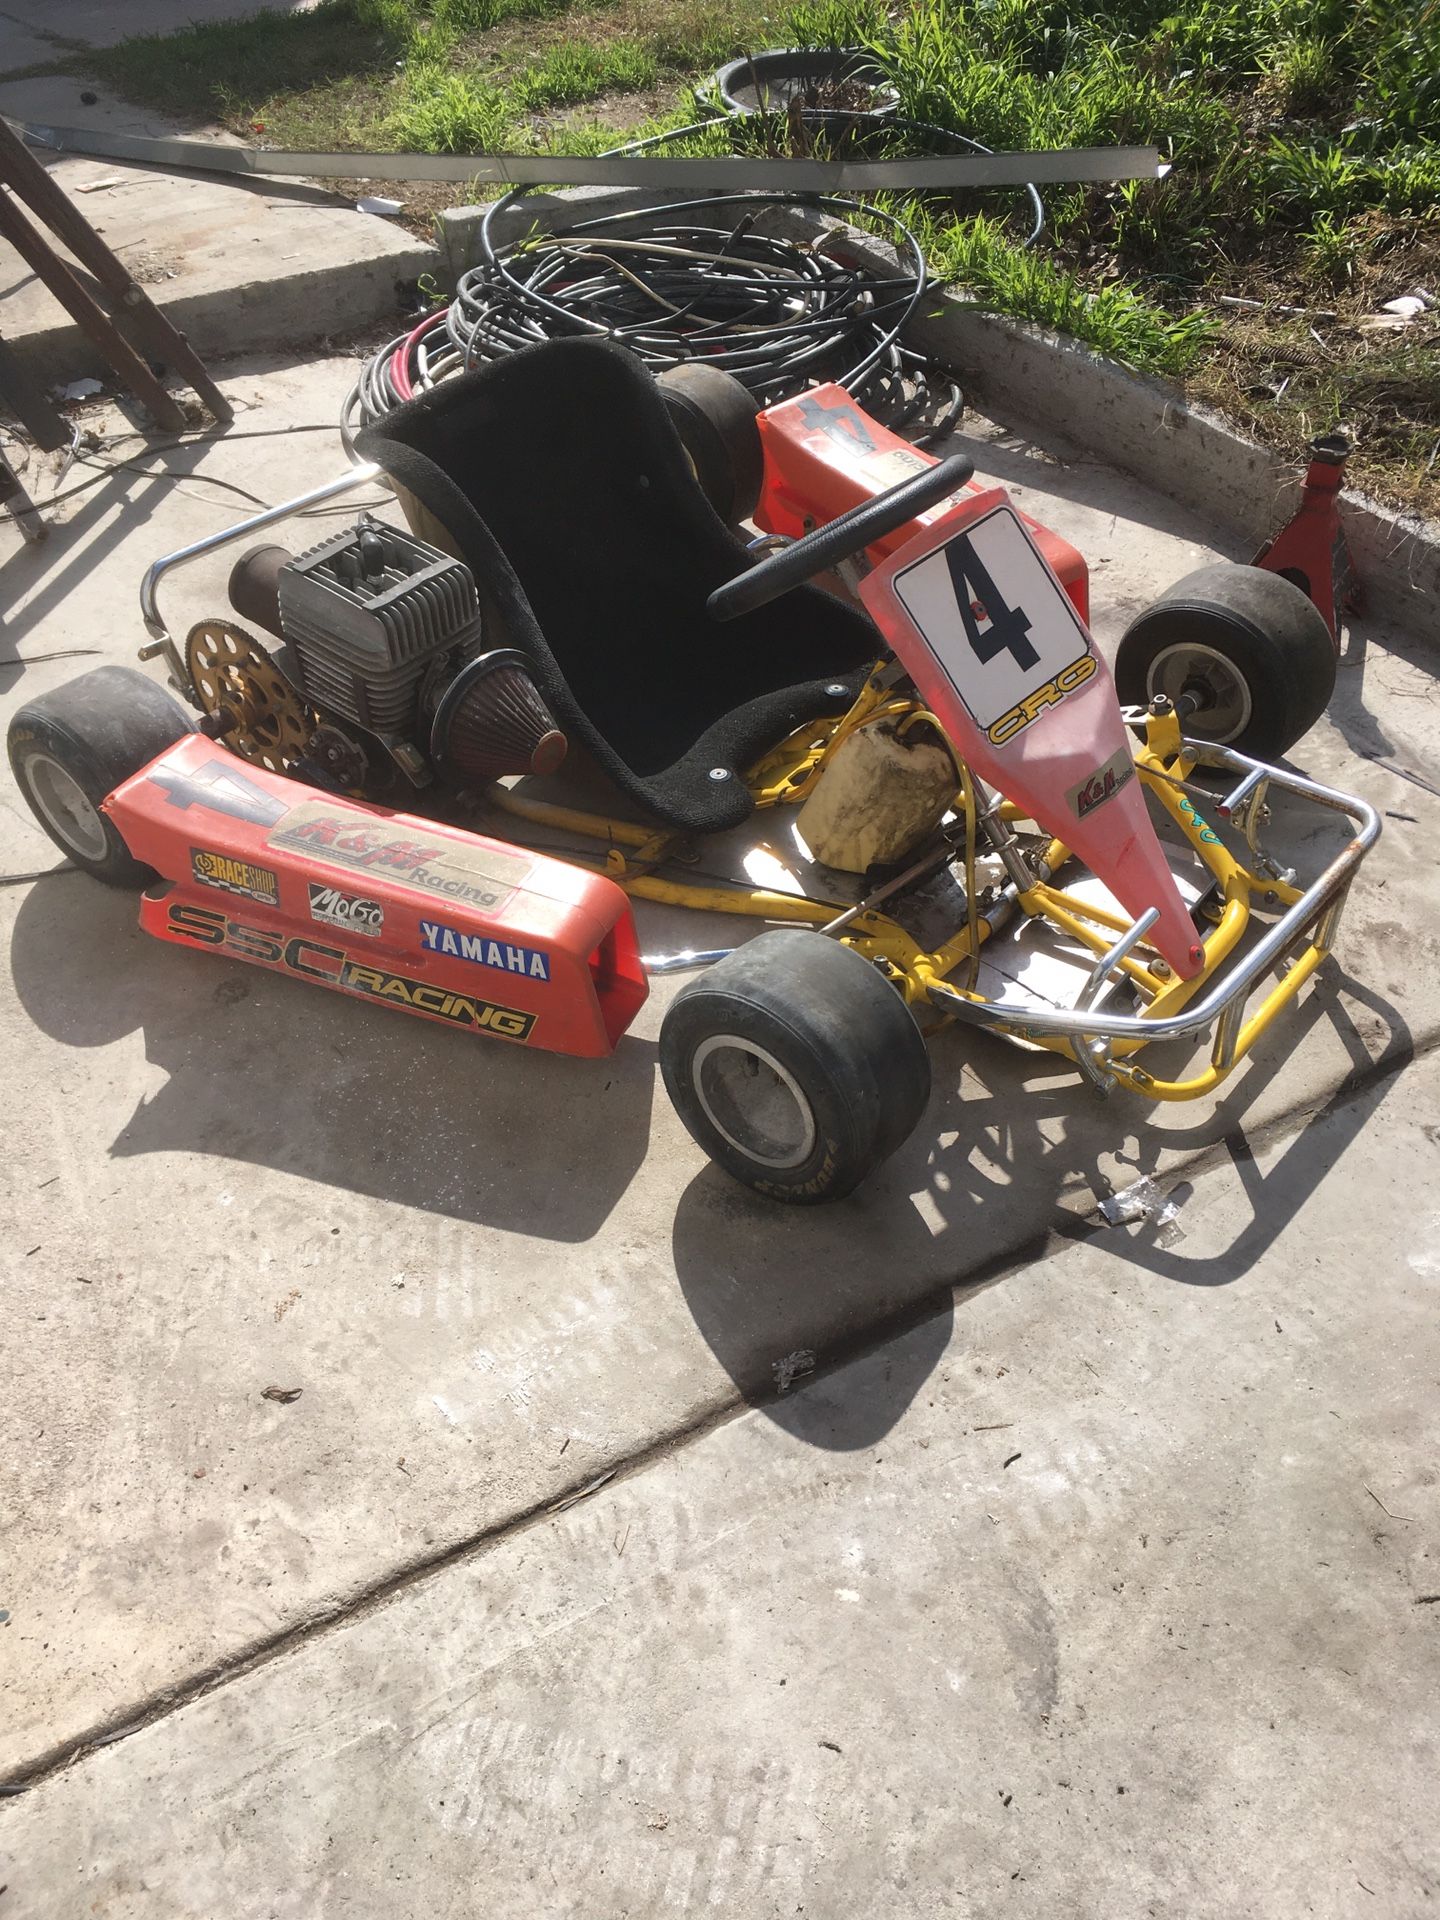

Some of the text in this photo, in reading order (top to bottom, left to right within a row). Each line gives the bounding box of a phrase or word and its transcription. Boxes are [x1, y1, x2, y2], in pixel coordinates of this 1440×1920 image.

[797, 398, 878, 459] 4
[944, 532, 1042, 673] 4
[988, 655, 1097, 745] CRG
[146, 758, 291, 829] 4
[1077, 767, 1116, 816] K&M
[283, 816, 498, 907] K&M Racing
[167, 902, 528, 1036] SSC RACING
[421, 922, 548, 980] YAMAHA
